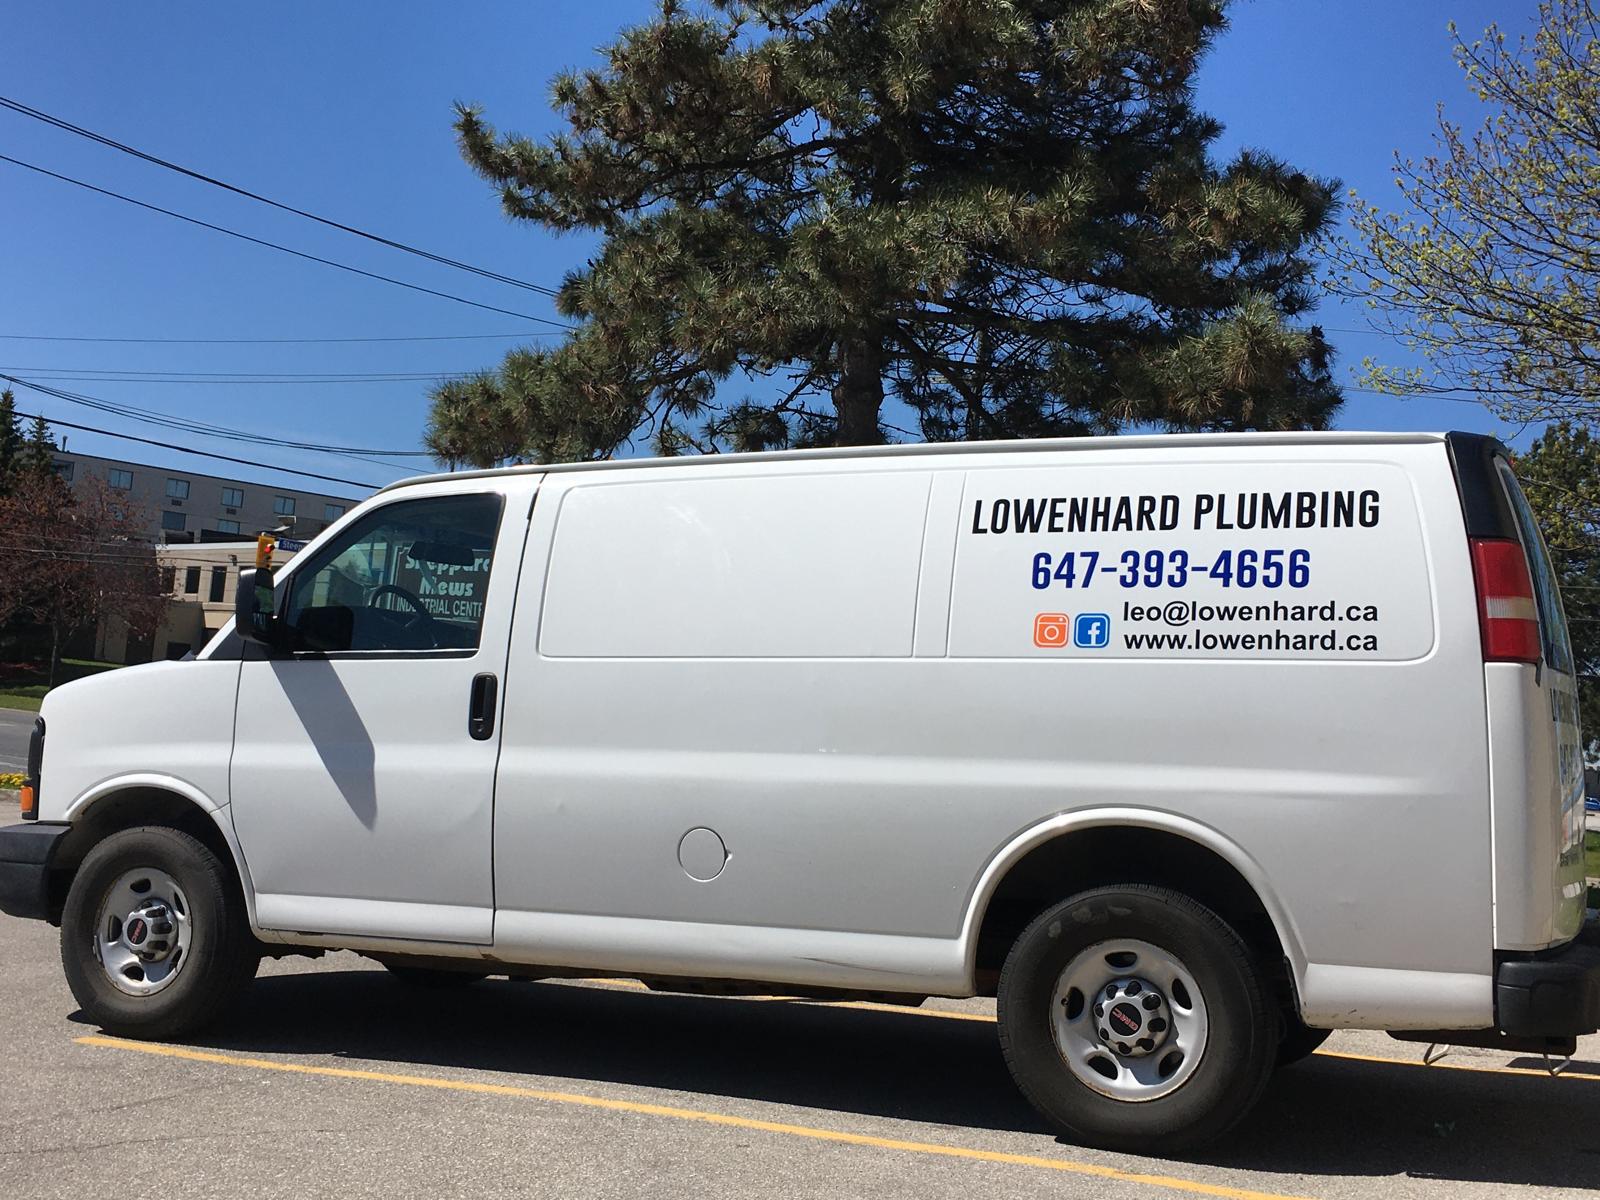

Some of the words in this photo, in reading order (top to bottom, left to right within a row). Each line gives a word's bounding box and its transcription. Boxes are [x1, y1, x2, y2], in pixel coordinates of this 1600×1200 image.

[972, 494, 1180, 535] LOWENHARD
[1193, 489, 1380, 530] PLUMBING
[405, 555, 490, 575] Seppr
[1031, 548, 1311, 590] 647-393-4656
[419, 576, 474, 597] Mews
[397, 597, 450, 614] INDTRIAL
[1123, 600, 1378, 627] leo@lowenhard.ca
[1123, 629, 1378, 651] www.lowenhard.ca
[1112, 1007, 1139, 1031] GMC
